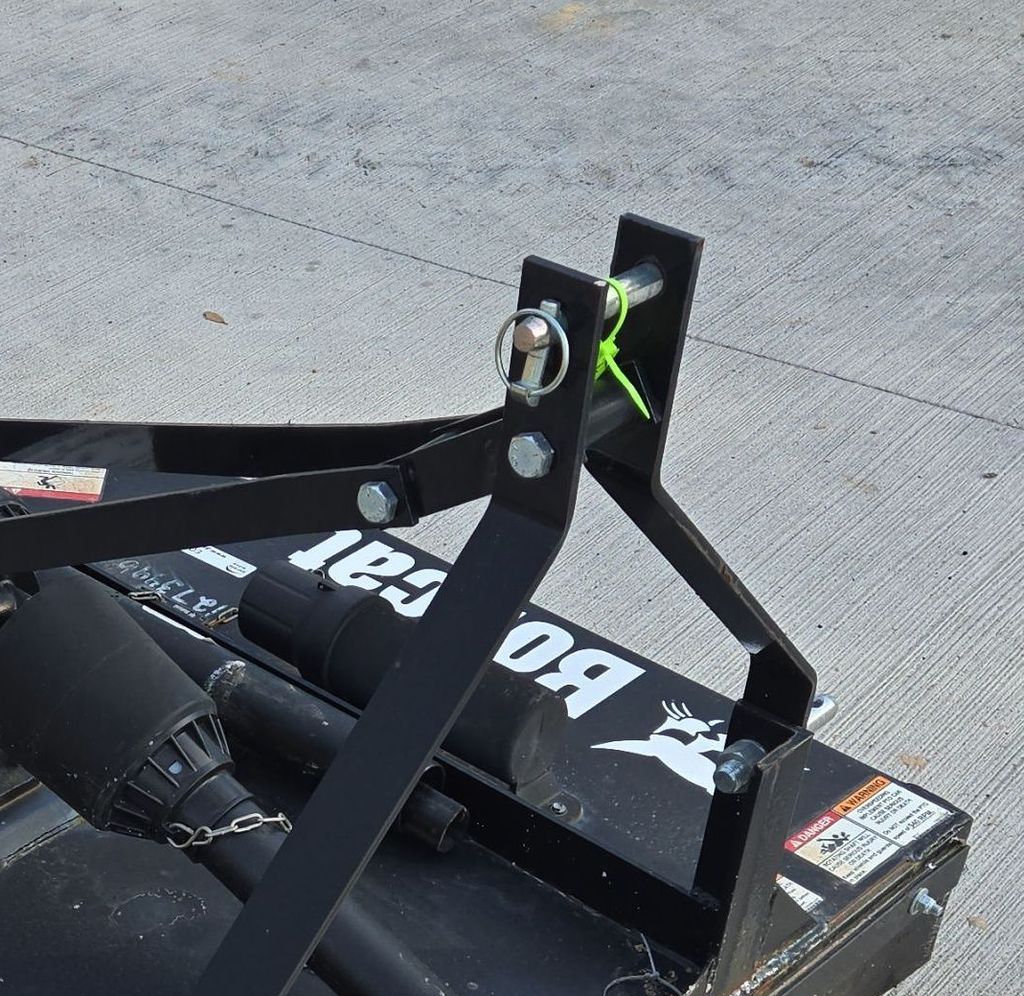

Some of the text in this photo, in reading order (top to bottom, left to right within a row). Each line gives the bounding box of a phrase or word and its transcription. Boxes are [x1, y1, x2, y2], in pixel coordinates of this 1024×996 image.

[288, 529, 645, 719] Bocat
[847, 778, 886, 805] WARNING
[798, 815, 834, 840] DANGER
